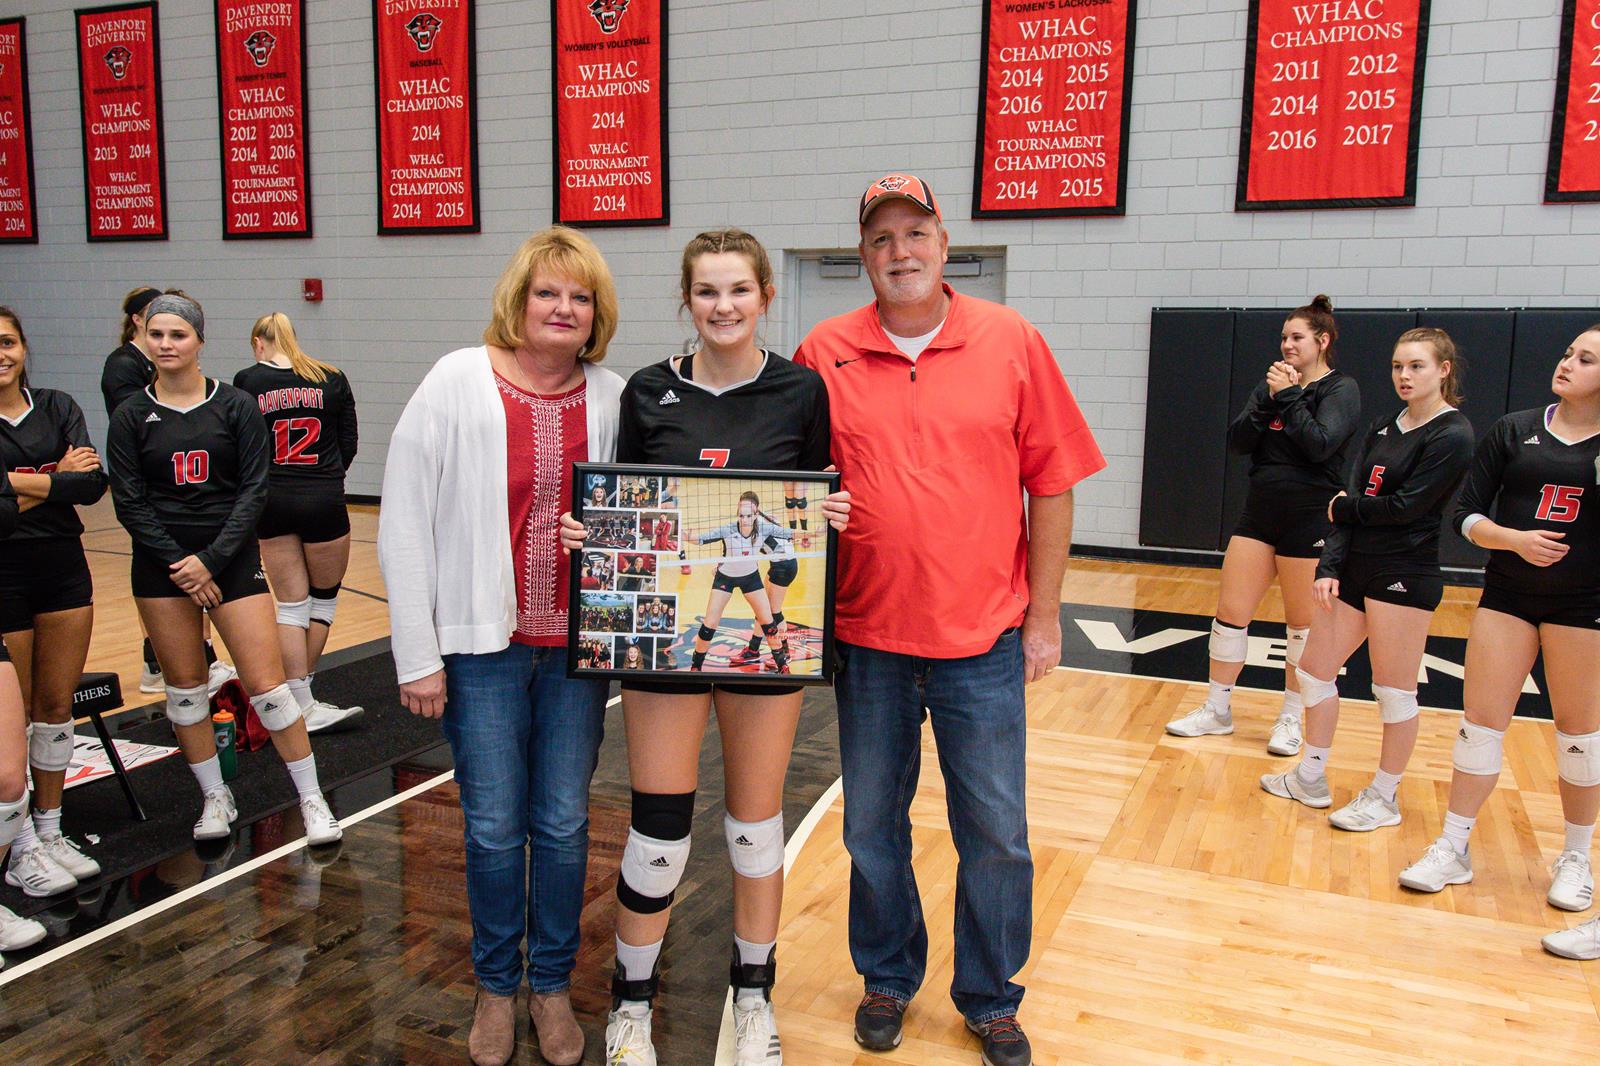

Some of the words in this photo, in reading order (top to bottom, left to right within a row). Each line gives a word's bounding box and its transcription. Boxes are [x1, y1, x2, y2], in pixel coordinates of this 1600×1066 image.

[227, 3, 292, 21] DAVENPORT
[1006, 2, 1055, 12] WOMEN'S
[1293, 0, 1384, 26] WHAC
[87, 20, 146, 36] DAVENPORT
[227, 15, 292, 32] UNIVERSITY
[1018, 16, 1097, 40] WHAC
[87, 31, 146, 47] UNIVERSITY
[564, 41, 604, 52] WOMEN'S
[607, 37, 651, 49] VOLLEYBALL
[1271, 23, 1403, 49] CHAMPIONS
[1000, 40, 1112, 63] CHAMPIONS
[578, 60, 638, 82] WHAC
[1000, 68, 1044, 88] 2014
[1066, 62, 1109, 84] 2015
[1272, 60, 1320, 82] 2011
[1347, 53, 1399, 77] 2012
[239, 86, 285, 104] WHAC
[399, 77, 450, 97] WHAC
[565, 80, 650, 99] CHAMPIONS
[100, 101, 142, 118] WHAC
[386, 95, 464, 113] CHAMPIONS
[999, 95, 1043, 115] 2016
[1064, 91, 1108, 111] 2017
[1269, 95, 1318, 117] 2014
[1345, 88, 1396, 111] 2015
[228, 104, 295, 121] CHAMPIONS
[592, 112, 625, 130] 2014
[91, 119, 151, 136] CHAMPIONS
[230, 126, 257, 142] 2012
[269, 123, 295, 140] 2013
[412, 124, 441, 142] 2014
[1026, 119, 1078, 134] WHAC
[997, 135, 1105, 152] TOURNAMENT
[1267, 129, 1317, 151] 2016
[1342, 124, 1394, 146] 2017
[94, 146, 118, 161] 2013
[128, 144, 152, 160] 2014
[231, 147, 258, 162] 2014
[270, 144, 296, 160] 2016
[589, 142, 629, 155] WHAC
[409, 153, 445, 166] WHAC
[567, 156, 649, 171] TOURNAMENT
[994, 152, 1107, 172] CHAMPIONS
[109, 172, 137, 184] WHAC
[249, 164, 280, 176] WHAC
[391, 167, 463, 180] TOURNAMENT
[232, 177, 296, 190] TOURNAMENT
[565, 171, 652, 189] CHAMPIONS
[95, 184, 151, 196] TOURNAMENT
[231, 190, 298, 205] CHAMPIONS
[389, 181, 465, 197] CHAMPIONS
[995, 179, 1039, 201] 2014
[1059, 177, 1104, 198] 2015
[95, 196, 154, 211] CHAMPIONS
[392, 202, 421, 219] 2014
[435, 202, 464, 218] 2015
[592, 195, 626, 212] 2014
[5, 217, 26, 231] 2014
[98, 216, 122, 230] 2013
[132, 215, 156, 229] 2014
[234, 212, 261, 228] 2012
[272, 211, 299, 226] 2016
[258, 387, 324, 414] DAVENPORT
[271, 416, 322, 466] 12
[171, 450, 209, 486] 10
[1364, 465, 1386, 497] 5
[1534, 484, 1585, 523] 15
